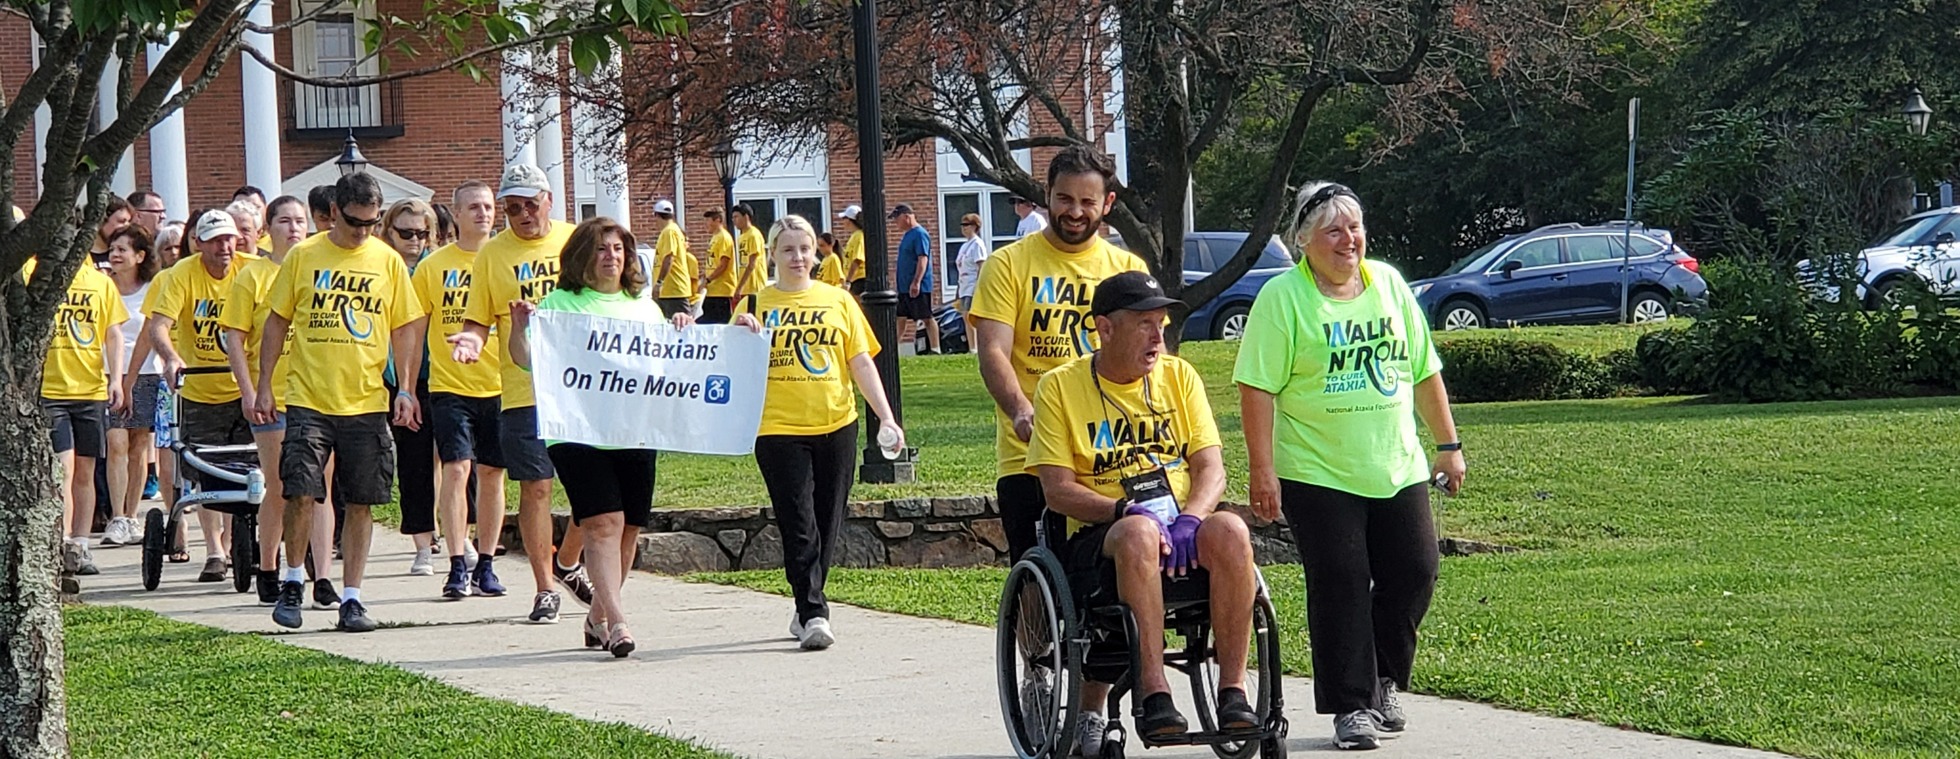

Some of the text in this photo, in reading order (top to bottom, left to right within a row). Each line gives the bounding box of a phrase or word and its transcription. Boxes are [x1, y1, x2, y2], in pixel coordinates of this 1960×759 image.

[313, 269, 375, 293] WALK
[442, 269, 472, 288] WA
[513, 260, 559, 282] WAL
[61, 292, 93, 306] ALK
[1031, 275, 1090, 306] WAL
[311, 291, 382, 318] N'ROLL
[308, 320, 340, 329] ATAXIA
[309, 312, 319, 320] TO
[762, 307, 827, 328] WALK
[1029, 308, 1099, 338] N'RO
[1030, 335, 1071, 346] TO CURE
[1322, 316, 1395, 348] WALK
[586, 330, 718, 361] MA Ataxians
[1027, 346, 1072, 358] ATAXIA
[1328, 340, 1408, 376] N'ROLL
[562, 366, 701, 400] On The Move
[1323, 379, 1367, 394] ATAXIA
[1325, 371, 1365, 383] TO CURE
[1325, 405, 1354, 415] National
[1086, 418, 1171, 449] WALK
